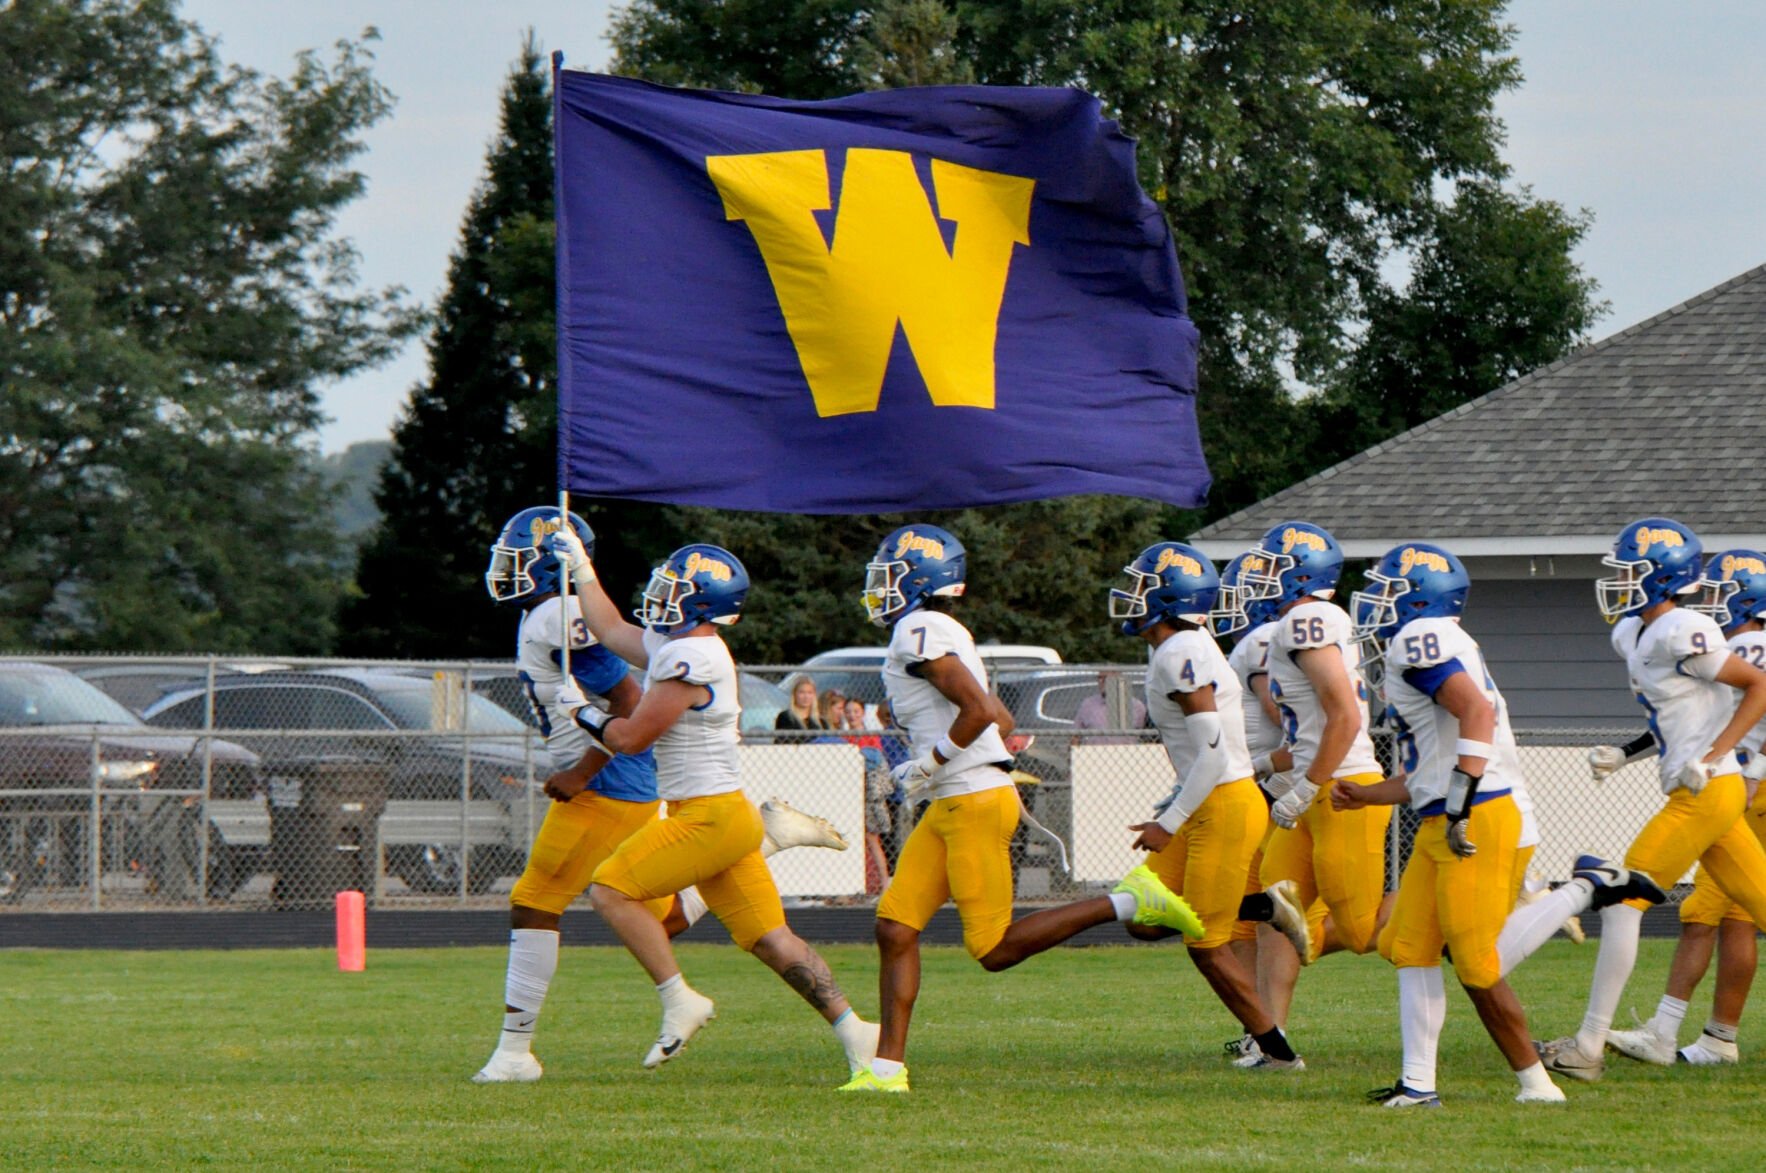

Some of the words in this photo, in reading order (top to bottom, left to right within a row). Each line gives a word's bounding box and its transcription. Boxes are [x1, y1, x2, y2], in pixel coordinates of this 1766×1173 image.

[706, 147, 1036, 418] W
[572, 618, 589, 644] 3
[911, 626, 926, 655] 7
[1292, 617, 1324, 644] 56
[1691, 632, 1707, 654] 9
[1404, 632, 1441, 664] 58
[1181, 659, 1195, 685] 4
